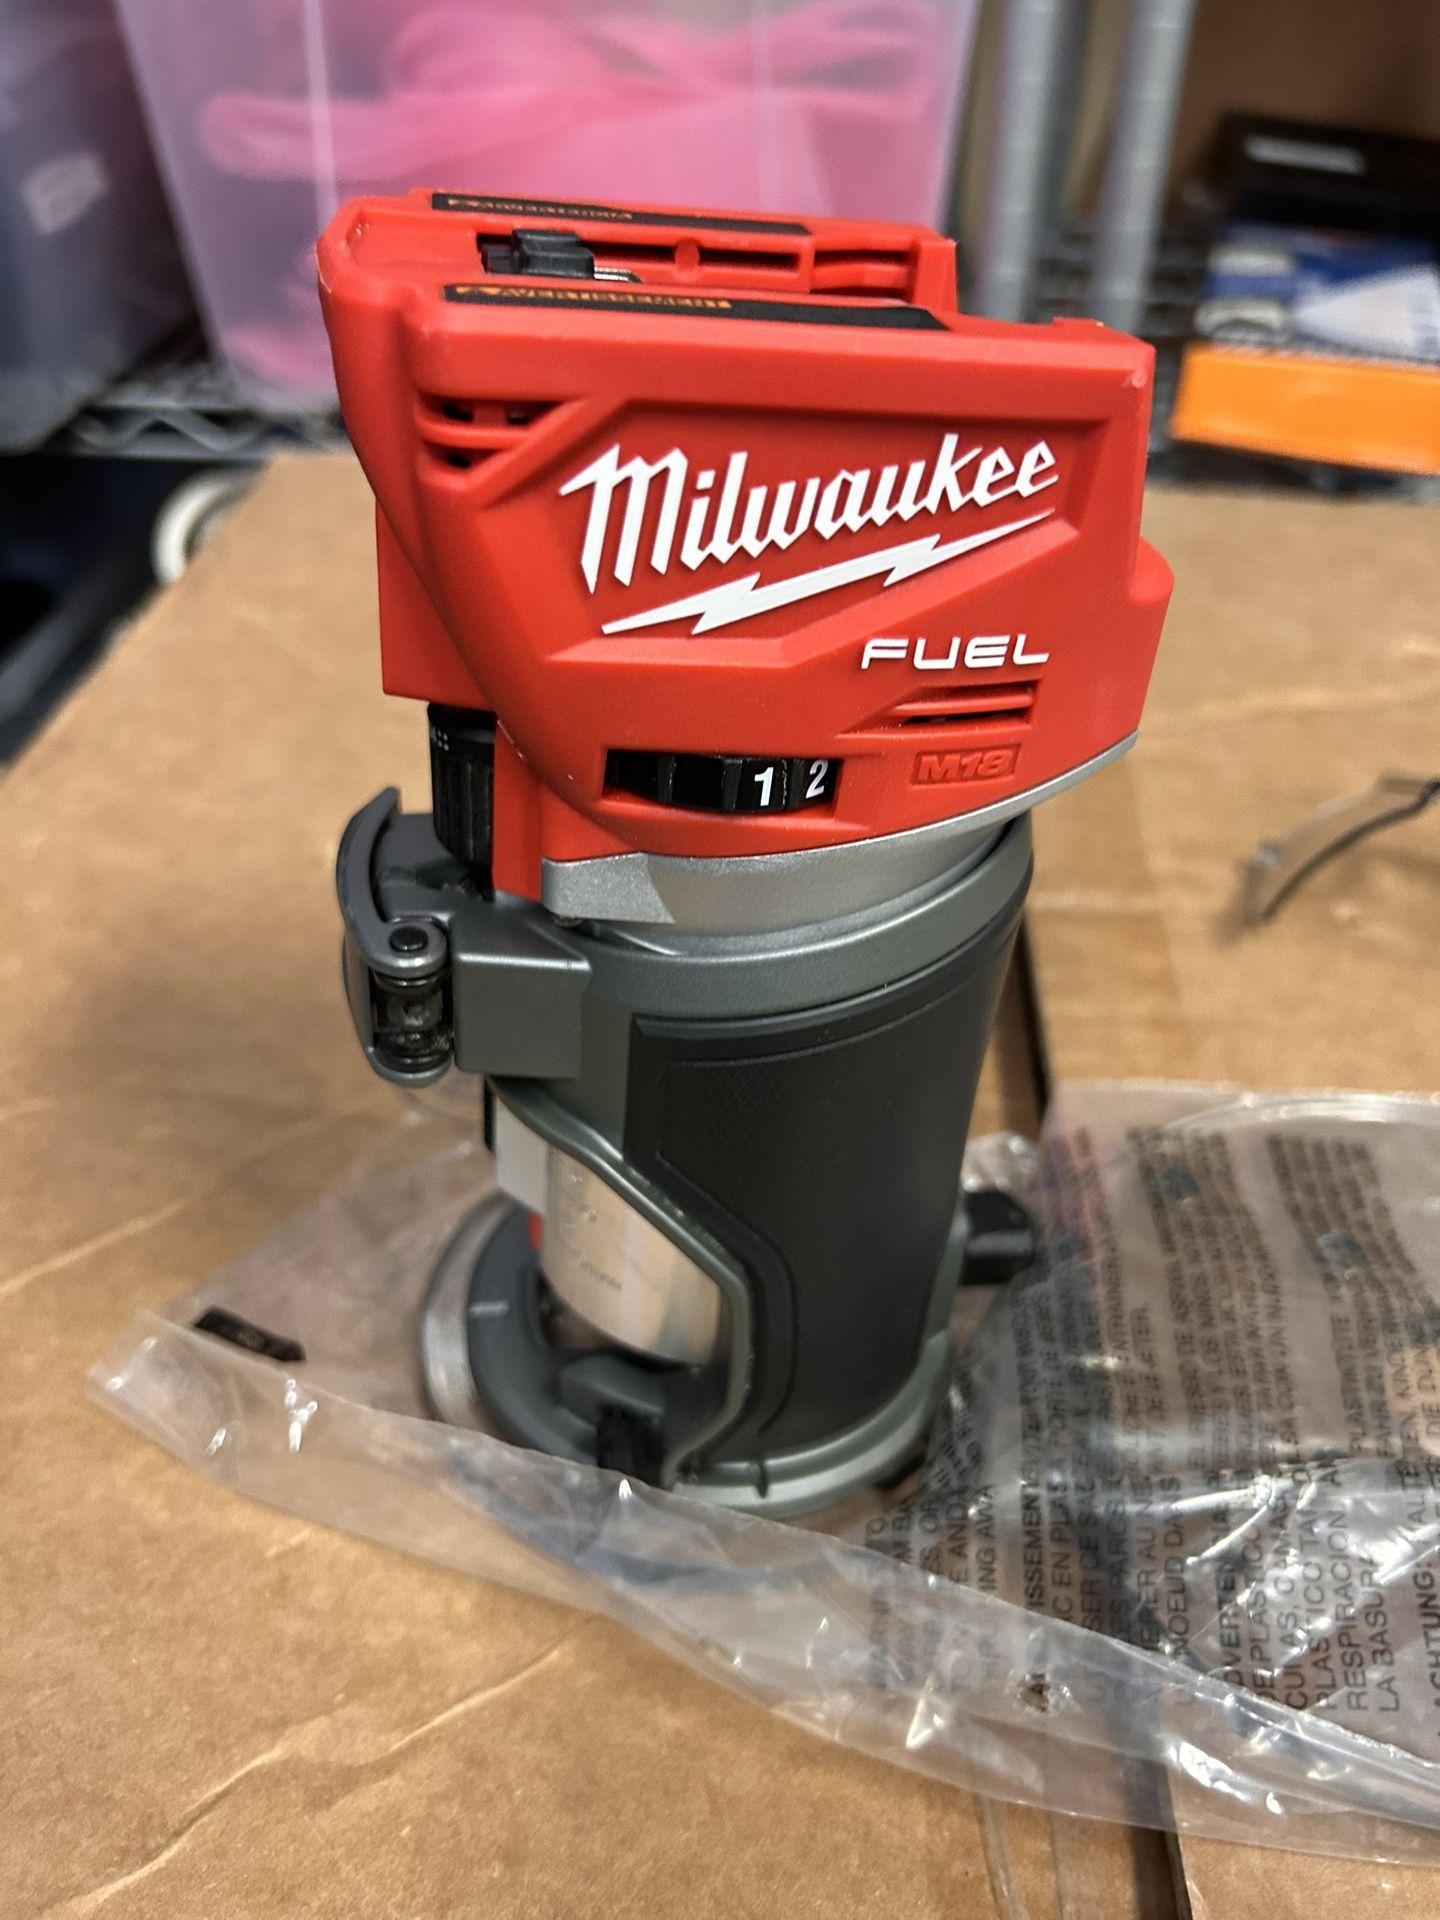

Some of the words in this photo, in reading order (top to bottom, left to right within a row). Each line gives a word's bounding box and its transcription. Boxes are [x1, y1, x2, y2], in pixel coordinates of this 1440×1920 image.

[560, 433, 1059, 594] Milwaukee
[861, 633, 1049, 669] FUEL
[754, 766, 774, 806] 1
[805, 759, 829, 798] 2
[918, 751, 1013, 781] M18
[1050, 1552, 1072, 1586] EN
[1376, 1676, 1400, 1713] LA
